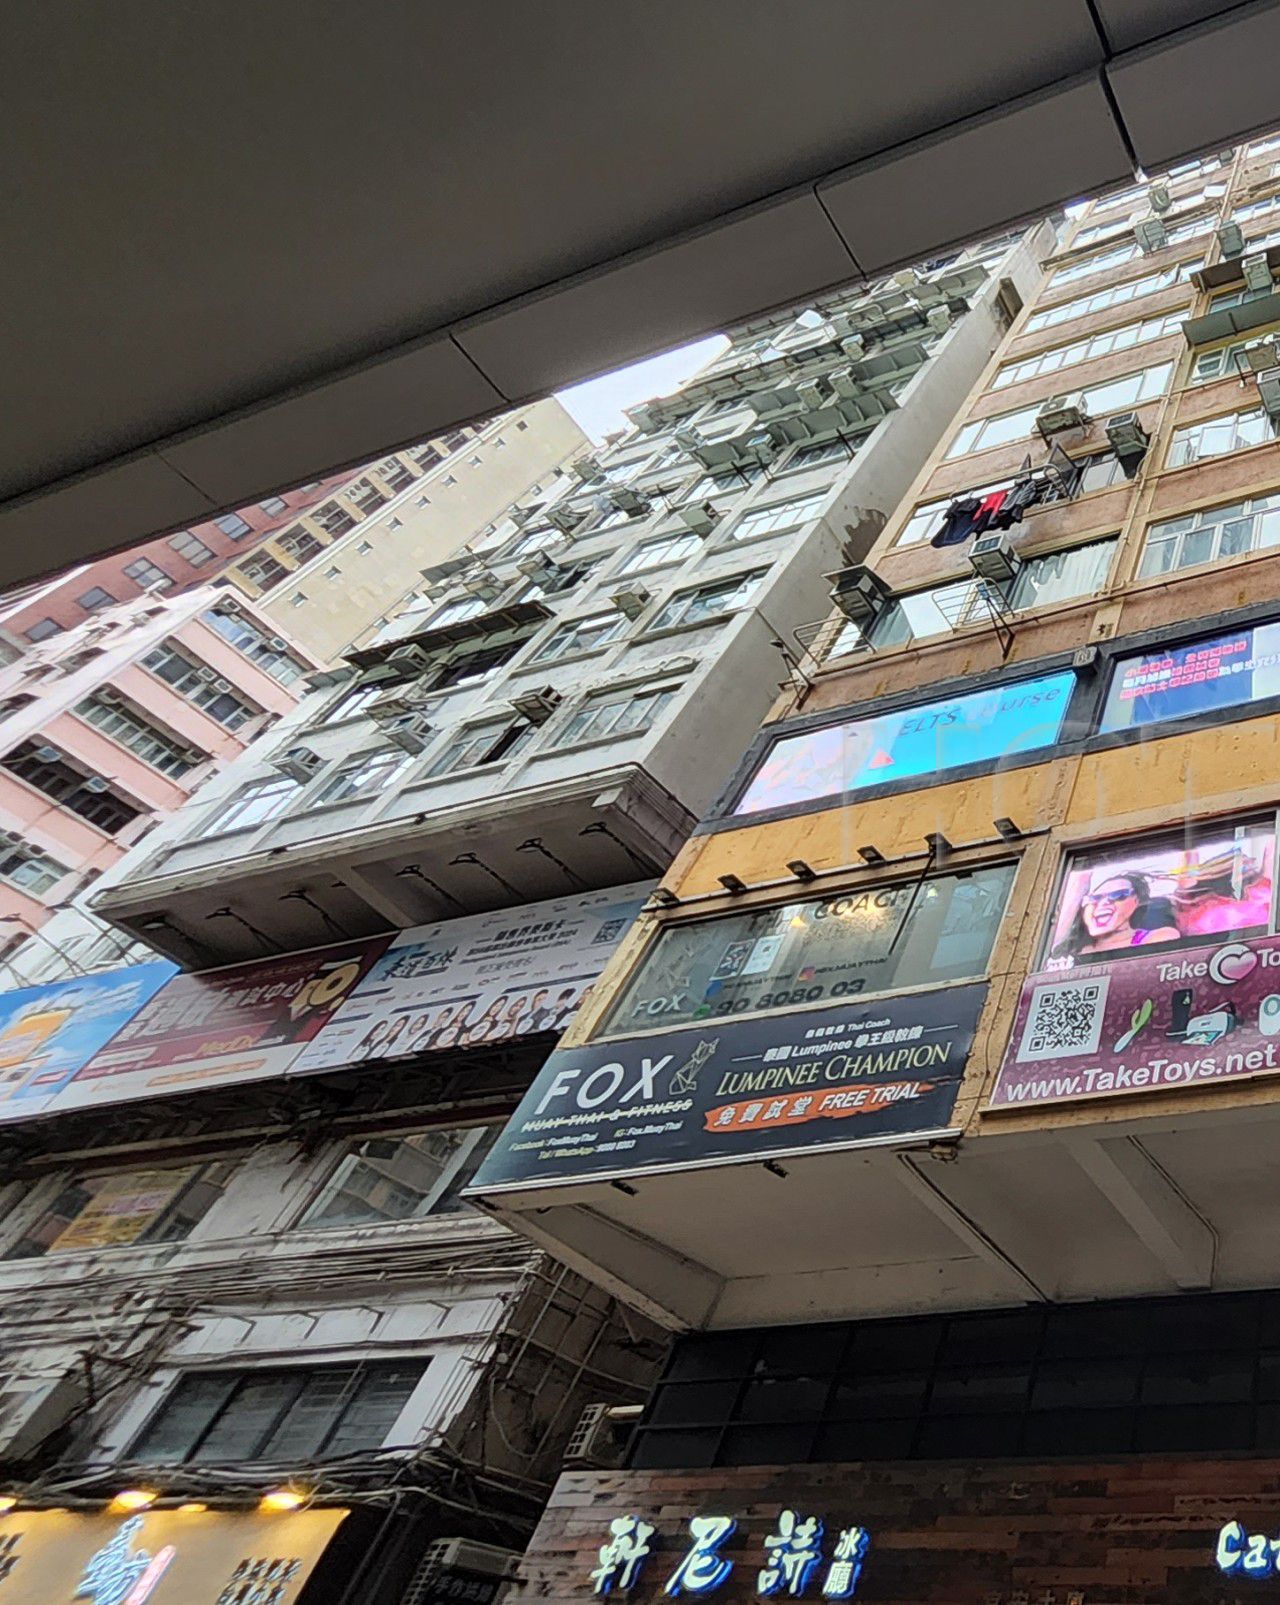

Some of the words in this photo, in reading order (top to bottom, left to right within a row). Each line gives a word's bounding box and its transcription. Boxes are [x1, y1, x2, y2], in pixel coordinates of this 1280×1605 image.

[1156, 959, 1208, 983] Take
[830, 977, 866, 998] 03
[631, 992, 687, 1018] FOX
[791, 1039, 852, 1058] Lumpinee
[534, 1055, 675, 1115] FOX
[1006, 1043, 1278, 1102] www.TakeToys.net
[818, 1090, 870, 1111] FREE
[870, 1082, 921, 1104] TRIAL
